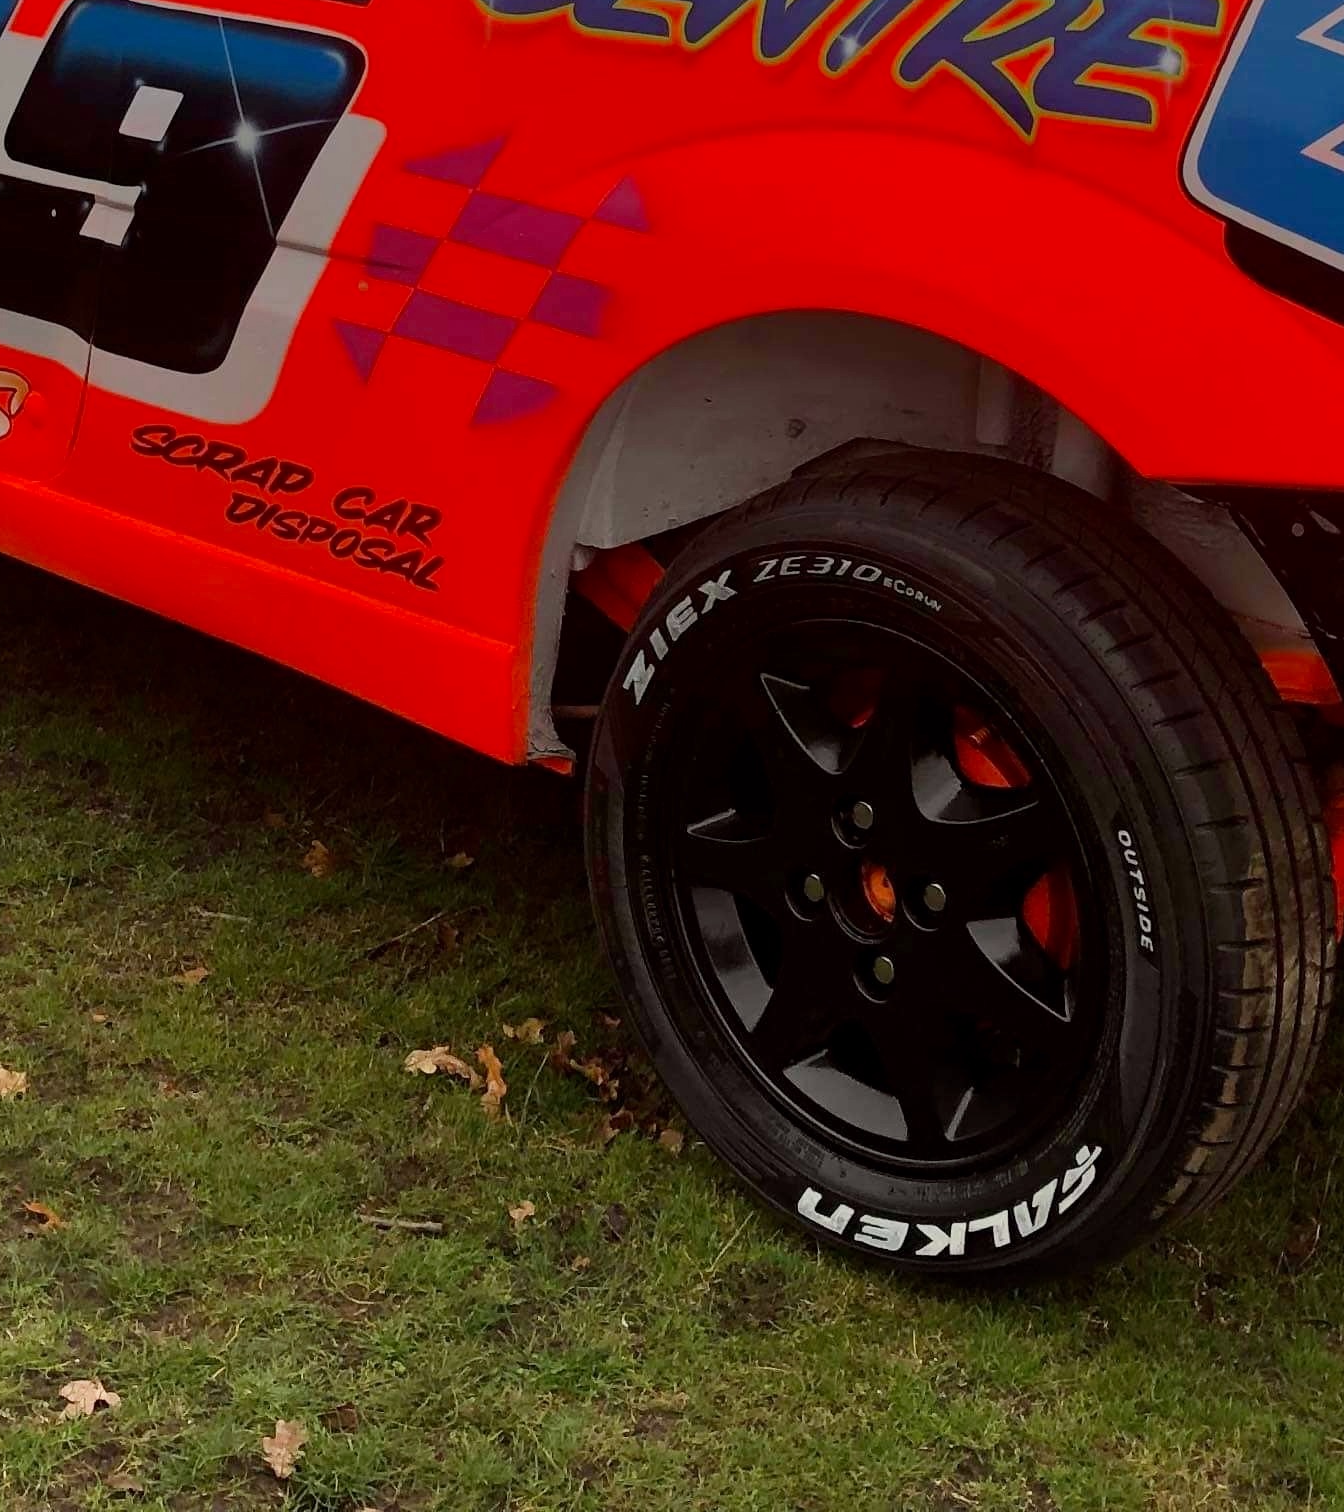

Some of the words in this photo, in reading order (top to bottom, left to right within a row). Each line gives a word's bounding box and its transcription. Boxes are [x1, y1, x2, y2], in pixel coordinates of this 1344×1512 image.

[129, 423, 315, 495] SCRAP
[331, 485, 443, 548] CAR
[223, 490, 445, 593] DISPOSAL
[622, 569, 738, 706] ZIEX
[752, 555, 883, 584] ZE310
[1117, 828, 1156, 954] OUTSIDE
[795, 1142, 1104, 1257] FALKEN
